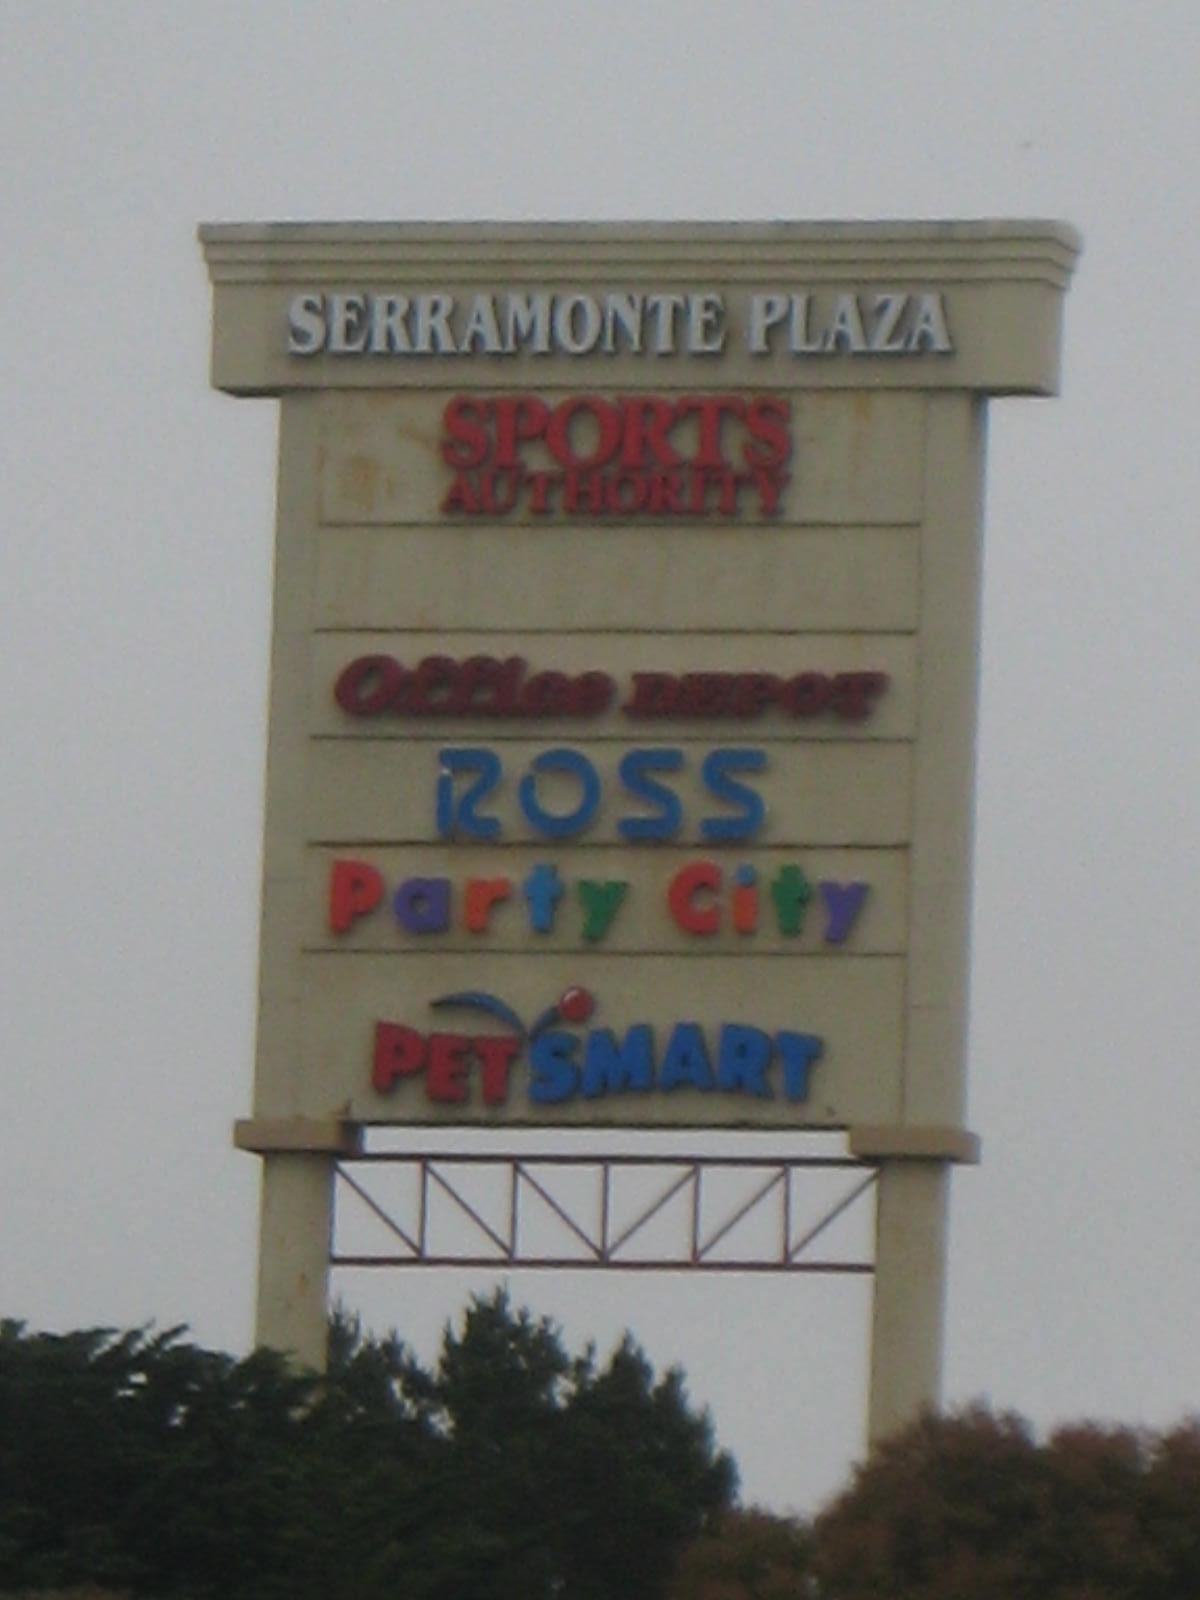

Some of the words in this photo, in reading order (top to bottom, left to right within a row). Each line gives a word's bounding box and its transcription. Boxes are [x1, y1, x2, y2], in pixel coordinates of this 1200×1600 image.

[287, 292, 725, 357] SERRAMONTE
[748, 291, 952, 356] PLAZA
[442, 393, 792, 470] SPORTS
[443, 465, 792, 518] AUTHORITY
[437, 748, 767, 842] ROSS
[329, 860, 629, 942] Party
[668, 861, 868, 944] City
